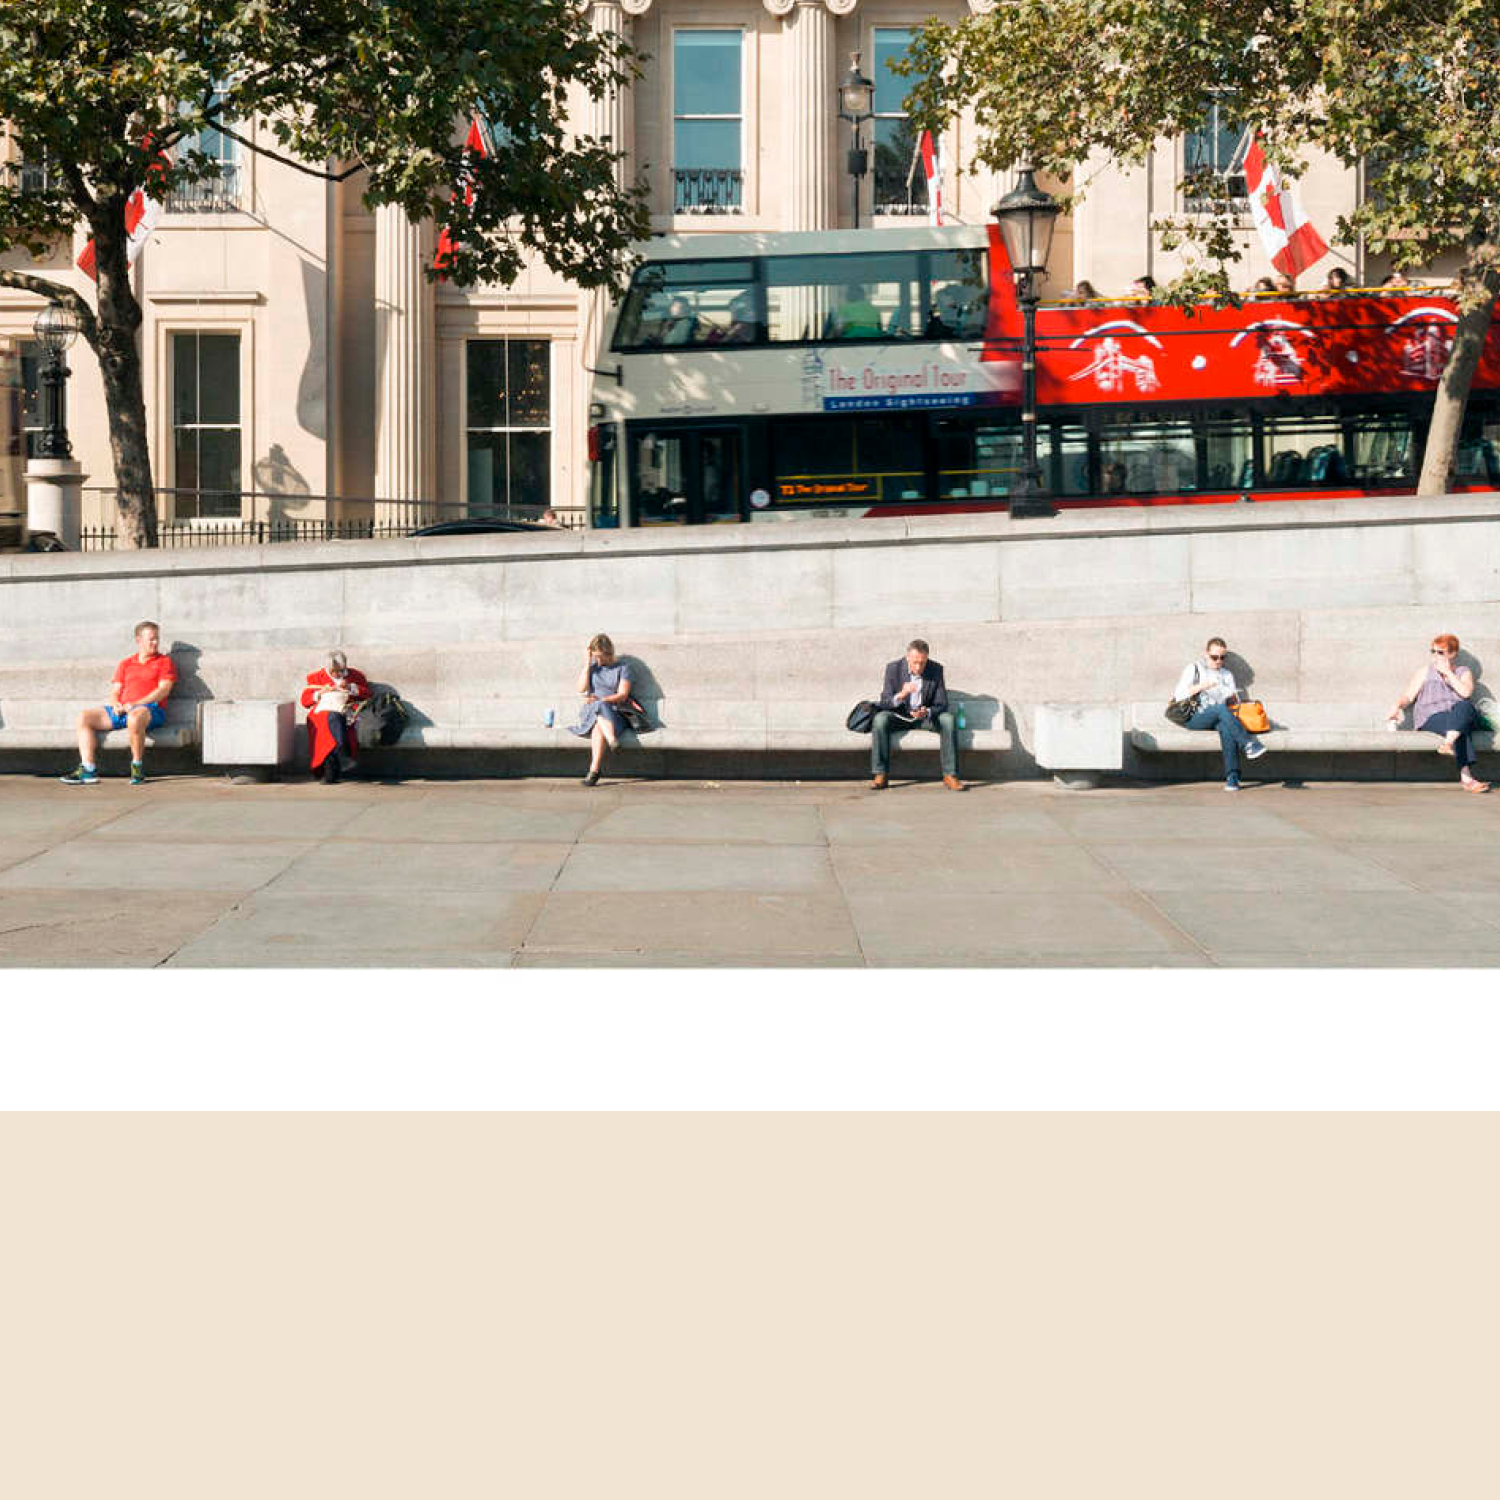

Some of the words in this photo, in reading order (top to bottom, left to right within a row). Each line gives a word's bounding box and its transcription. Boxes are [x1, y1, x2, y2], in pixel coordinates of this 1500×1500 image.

[827, 368, 856, 390] The
[863, 365, 928, 395] Original
[932, 364, 967, 388] Tour
